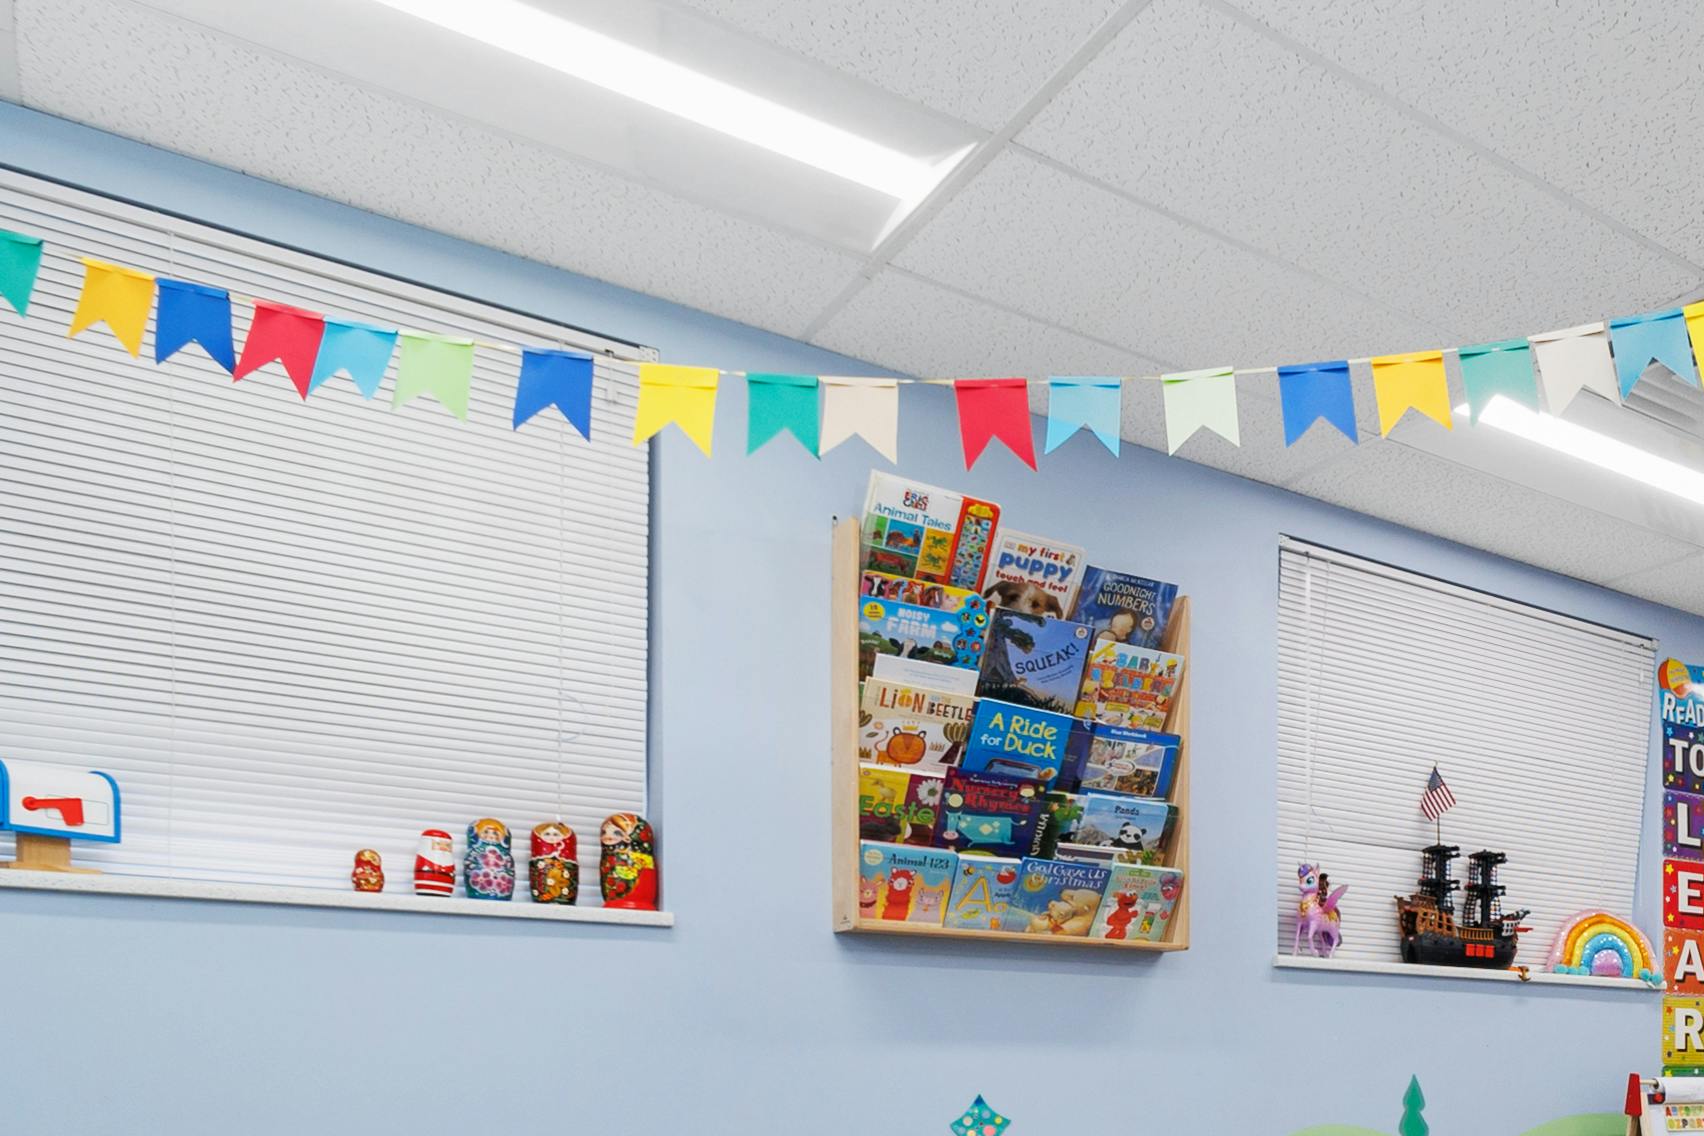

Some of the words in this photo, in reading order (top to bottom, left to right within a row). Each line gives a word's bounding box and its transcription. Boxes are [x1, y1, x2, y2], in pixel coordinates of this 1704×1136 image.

[874, 502, 918, 523] Animal
[921, 514, 952, 531] Tales
[1018, 543, 1037, 557] my
[1039, 546, 1065, 561] first
[998, 551, 1074, 582] puppy
[1047, 581, 1068, 593] feel
[1103, 581, 1158, 601] GOODNIGHT
[1097, 593, 1157, 616] NUMBERS
[886, 616, 937, 639] FARM
[1014, 642, 1080, 675] SQUEAK!
[926, 701, 973, 721] BEETLE
[989, 712, 1004, 732] A
[1009, 715, 1058, 740] Ride
[980, 733, 1003, 746] for
[1004, 733, 1057, 760] Duck
[1114, 805, 1140, 816] Panda
[888, 853, 927, 868] Animal
